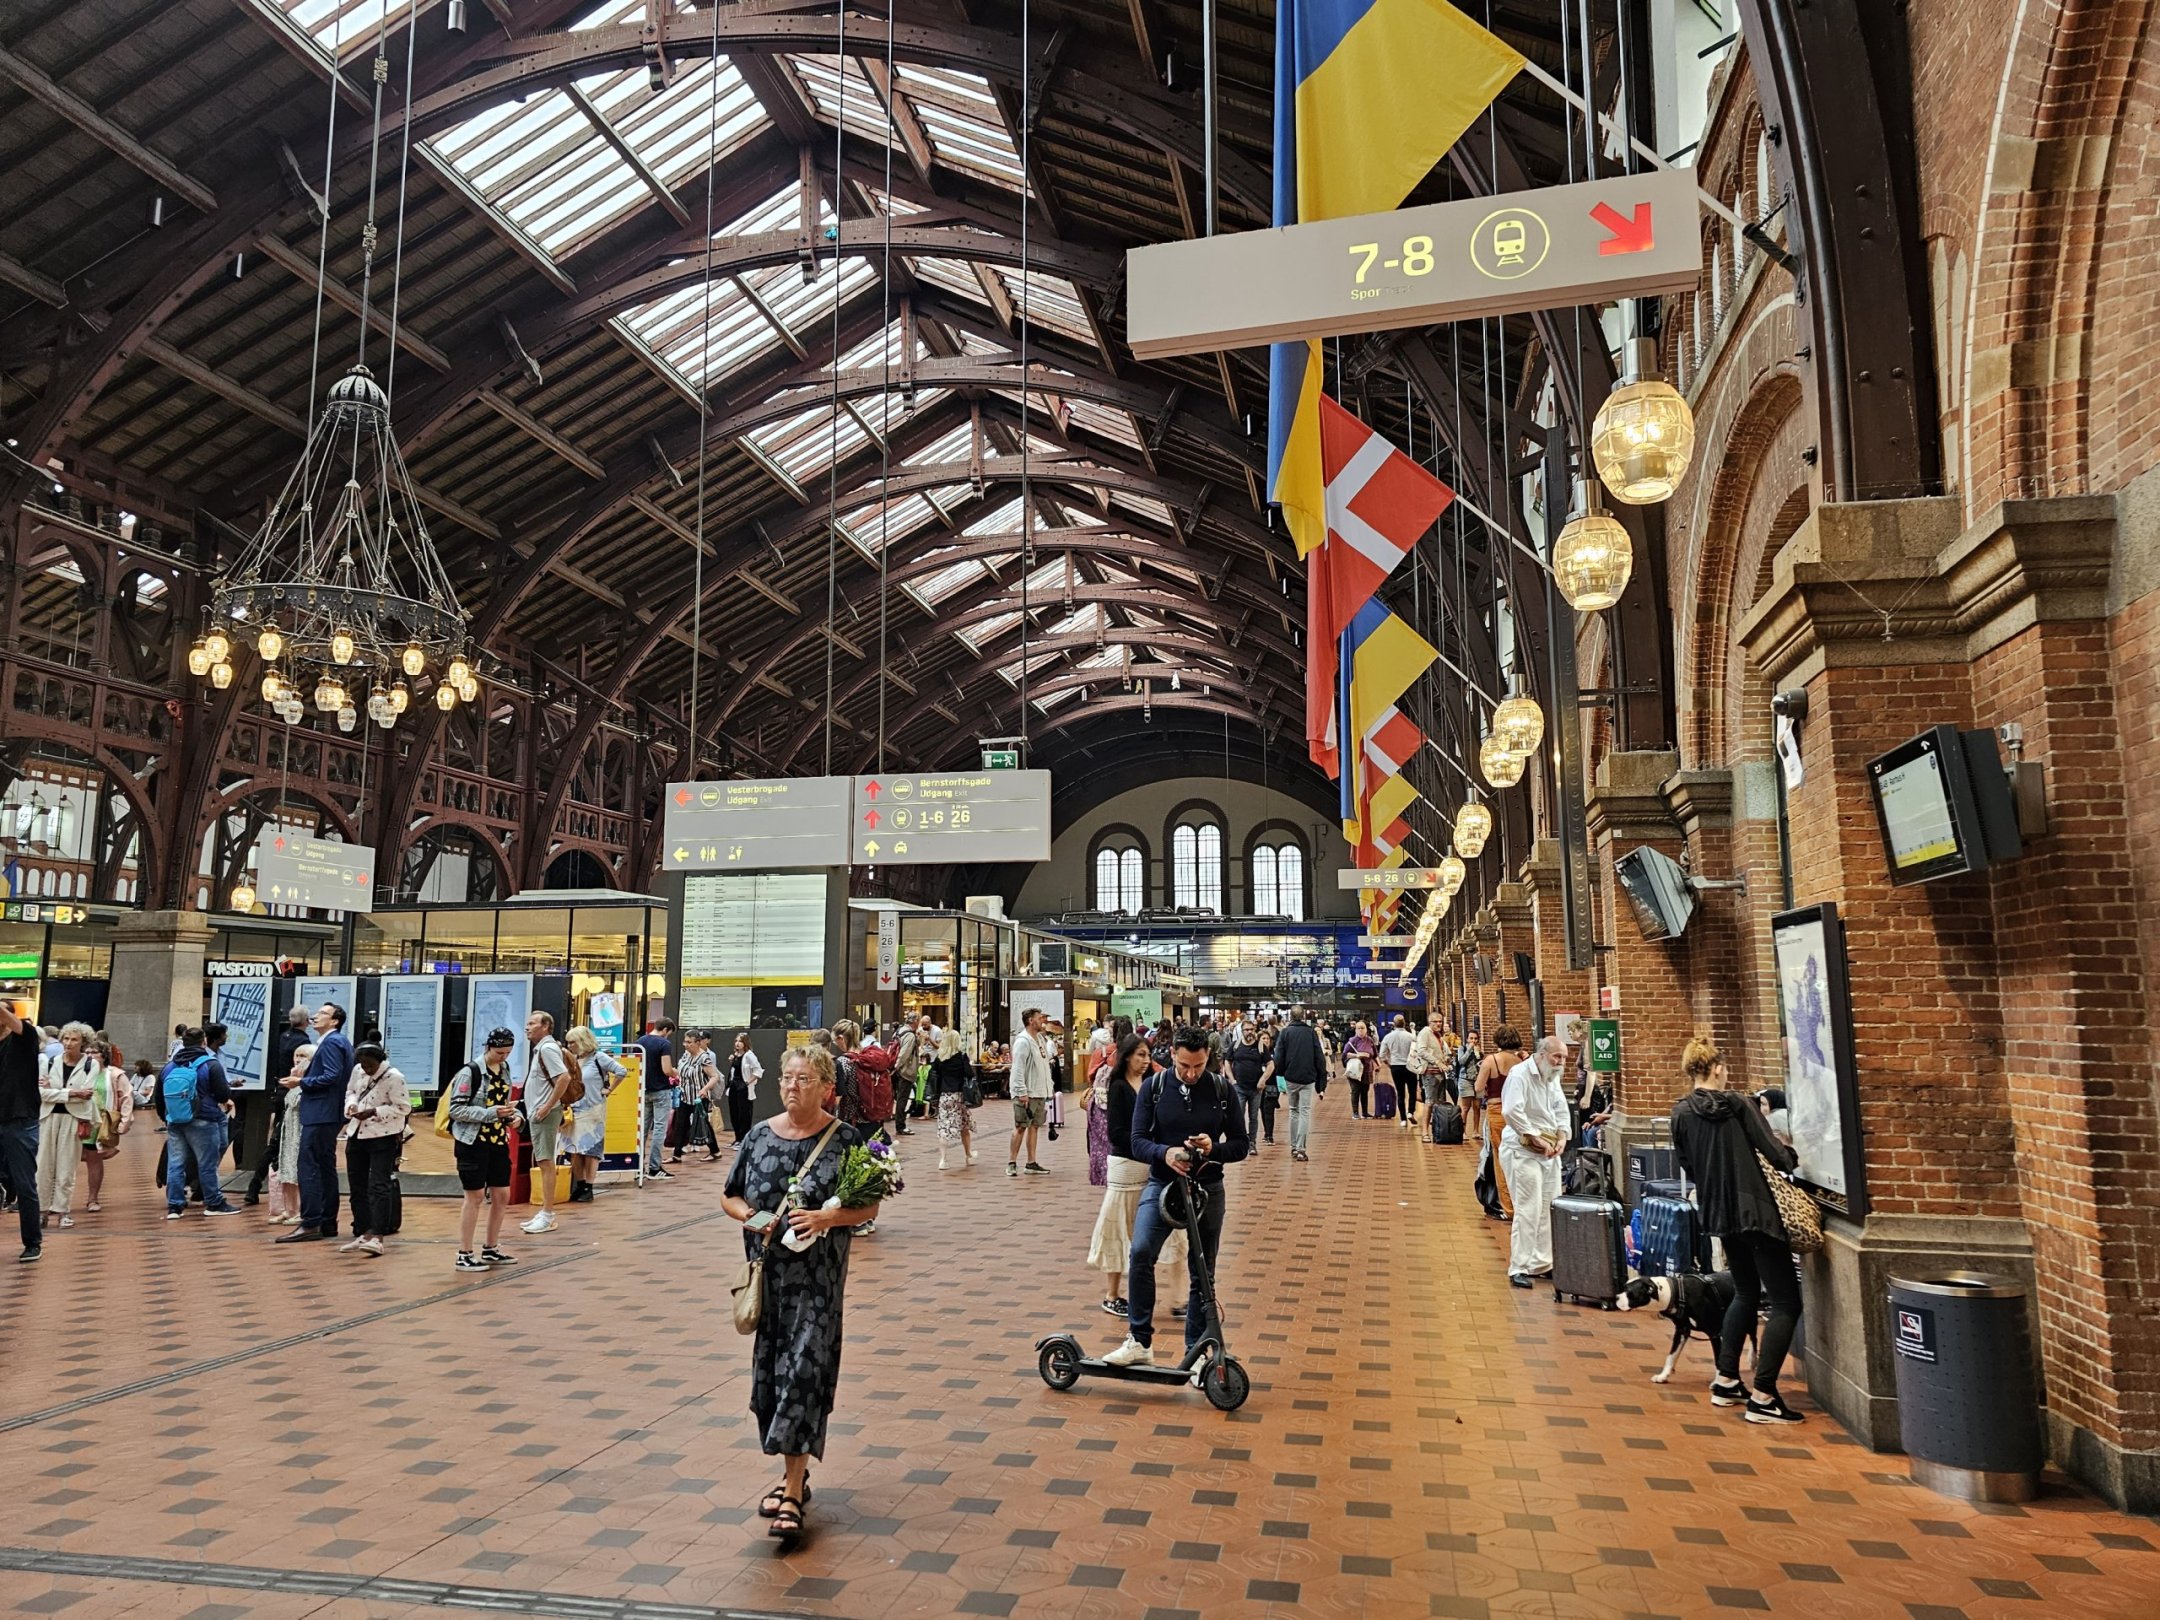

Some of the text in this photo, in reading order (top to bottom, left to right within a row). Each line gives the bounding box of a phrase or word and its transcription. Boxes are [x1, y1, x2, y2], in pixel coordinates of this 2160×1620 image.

[1349, 235, 1434, 284] 7-8
[1350, 288, 1381, 301] Spor
[920, 777, 991, 788] Bernstorffsgade
[727, 785, 788, 795] Vesterbrogade
[920, 789, 953, 799] Udgang
[727, 796, 758, 805] Udgang
[919, 810, 970, 825] 1-6 26
[1364, 873, 1399, 884] 5-6 26
[881, 919, 895, 928] 5-6
[881, 937, 893, 946] 26
[207, 961, 274, 977] PASFOTO
